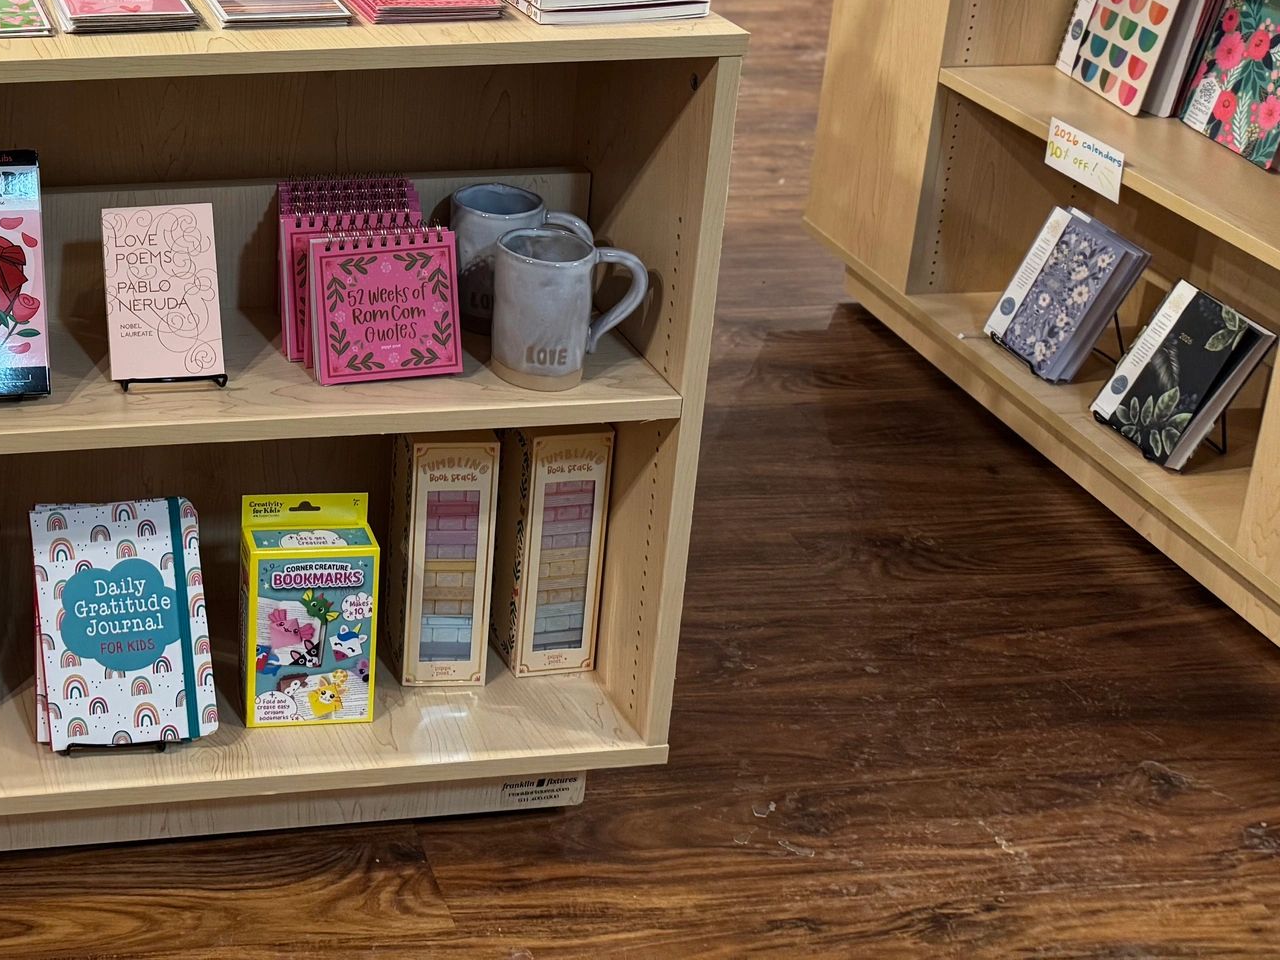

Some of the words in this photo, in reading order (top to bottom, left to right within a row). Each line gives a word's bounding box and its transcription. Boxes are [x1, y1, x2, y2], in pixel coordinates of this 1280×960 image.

[1054, 124, 1079, 146] 2026
[114, 233, 158, 248] LOVE
[116, 250, 172, 265] POEMS
[117, 279, 171, 294] PABLO
[347, 288, 365, 307] 52
[412, 281, 428, 300] of
[119, 297, 189, 313] NERUDA
[120, 330, 153, 338] LAUREATE
[364, 322, 418, 343] Quotes
[524, 346, 569, 367] LOVE
[420, 455, 490, 475] TUMBLING
[249, 500, 284, 508] Creativity
[286, 563, 314, 573] CORNER
[314, 563, 349, 572] CREATURE
[93, 576, 147, 597] Daily
[273, 570, 362, 587] BOOKMARKS
[74, 594, 171, 619] Gratitude
[354, 607, 364, 616] 10
[86, 614, 164, 636] Journal
[100, 642, 124, 655] FOR
[127, 638, 156, 651] KIDS
[502, 780, 535, 792] franklin
[545, 776, 578, 787] fixtures
